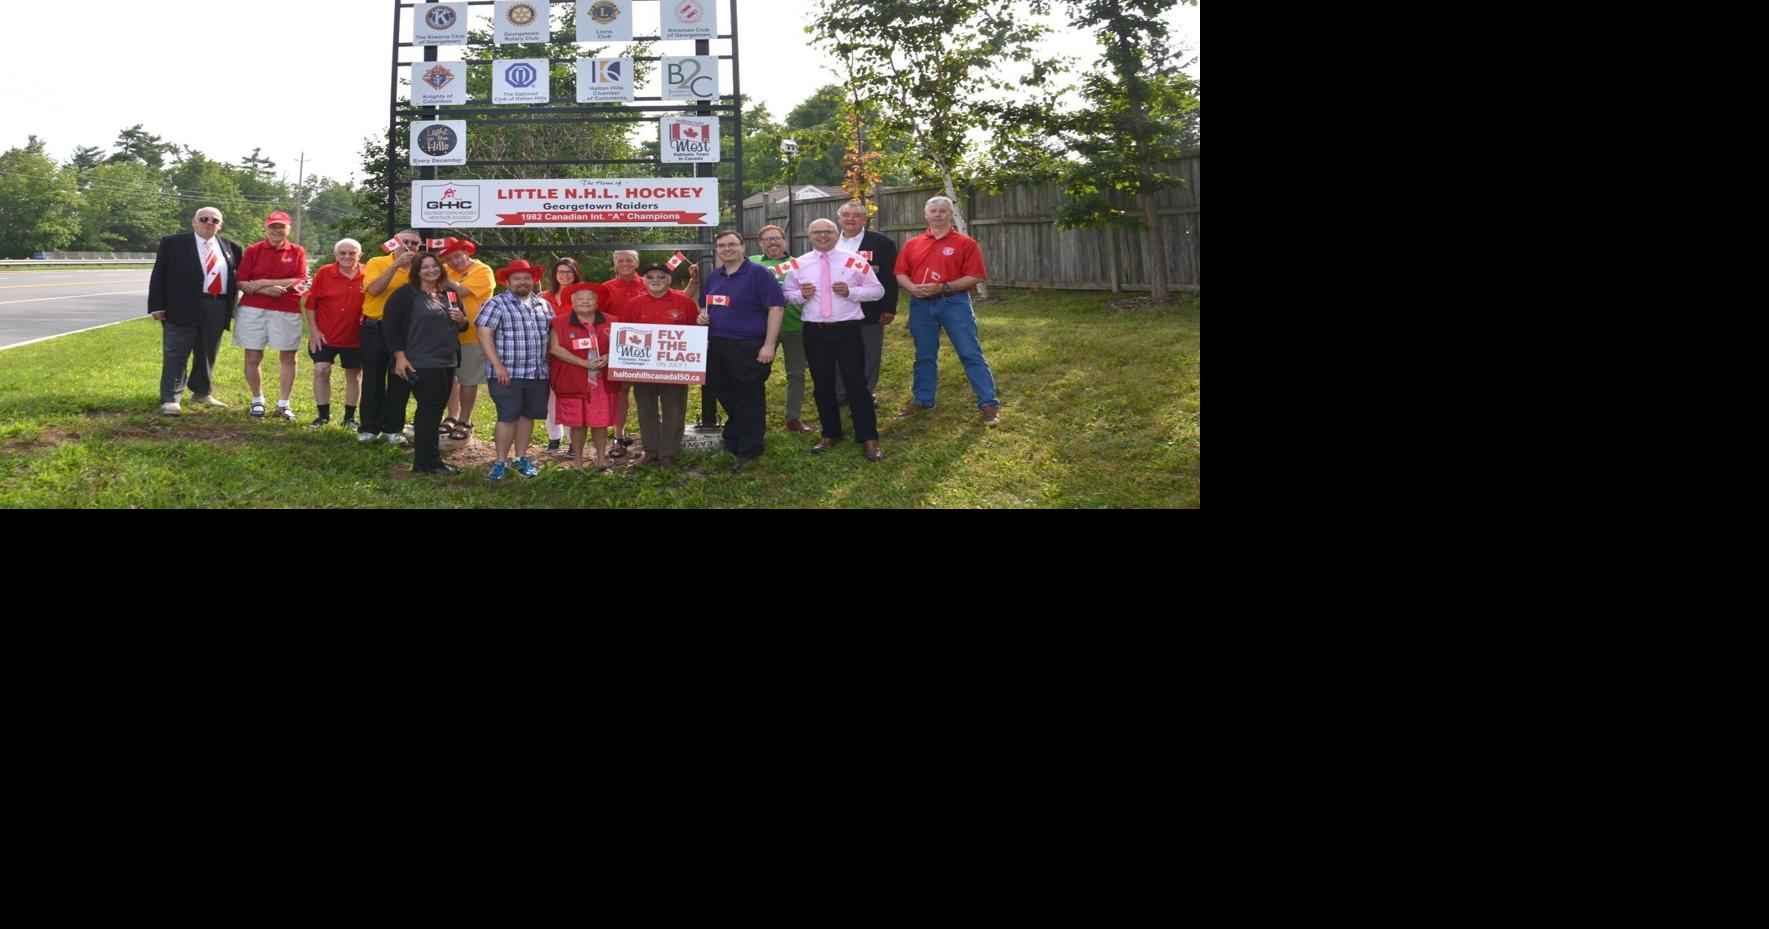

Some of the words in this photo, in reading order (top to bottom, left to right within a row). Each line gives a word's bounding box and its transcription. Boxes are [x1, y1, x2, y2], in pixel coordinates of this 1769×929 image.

[668, 58, 713, 98] B2C
[670, 137, 711, 152] Most
[497, 188, 558, 200] LITTLE
[564, 188, 619, 199] N.H.L.
[625, 187, 704, 199] HOCKEY
[426, 200, 472, 210] GHHC
[543, 202, 612, 212] Georgetown
[615, 202, 659, 210] Raiders
[521, 213, 542, 221] 1982
[544, 212, 588, 221] Canadian
[590, 213, 605, 221] Int.
[607, 212, 625, 220] "A"
[627, 212, 681, 222] Champions
[658, 329, 685, 340] FLY
[616, 344, 652, 358] Most
[657, 340, 687, 351] THE
[656, 351, 701, 363] FLAG!
[613, 370, 700, 382] haltonhillscanada150.ca
